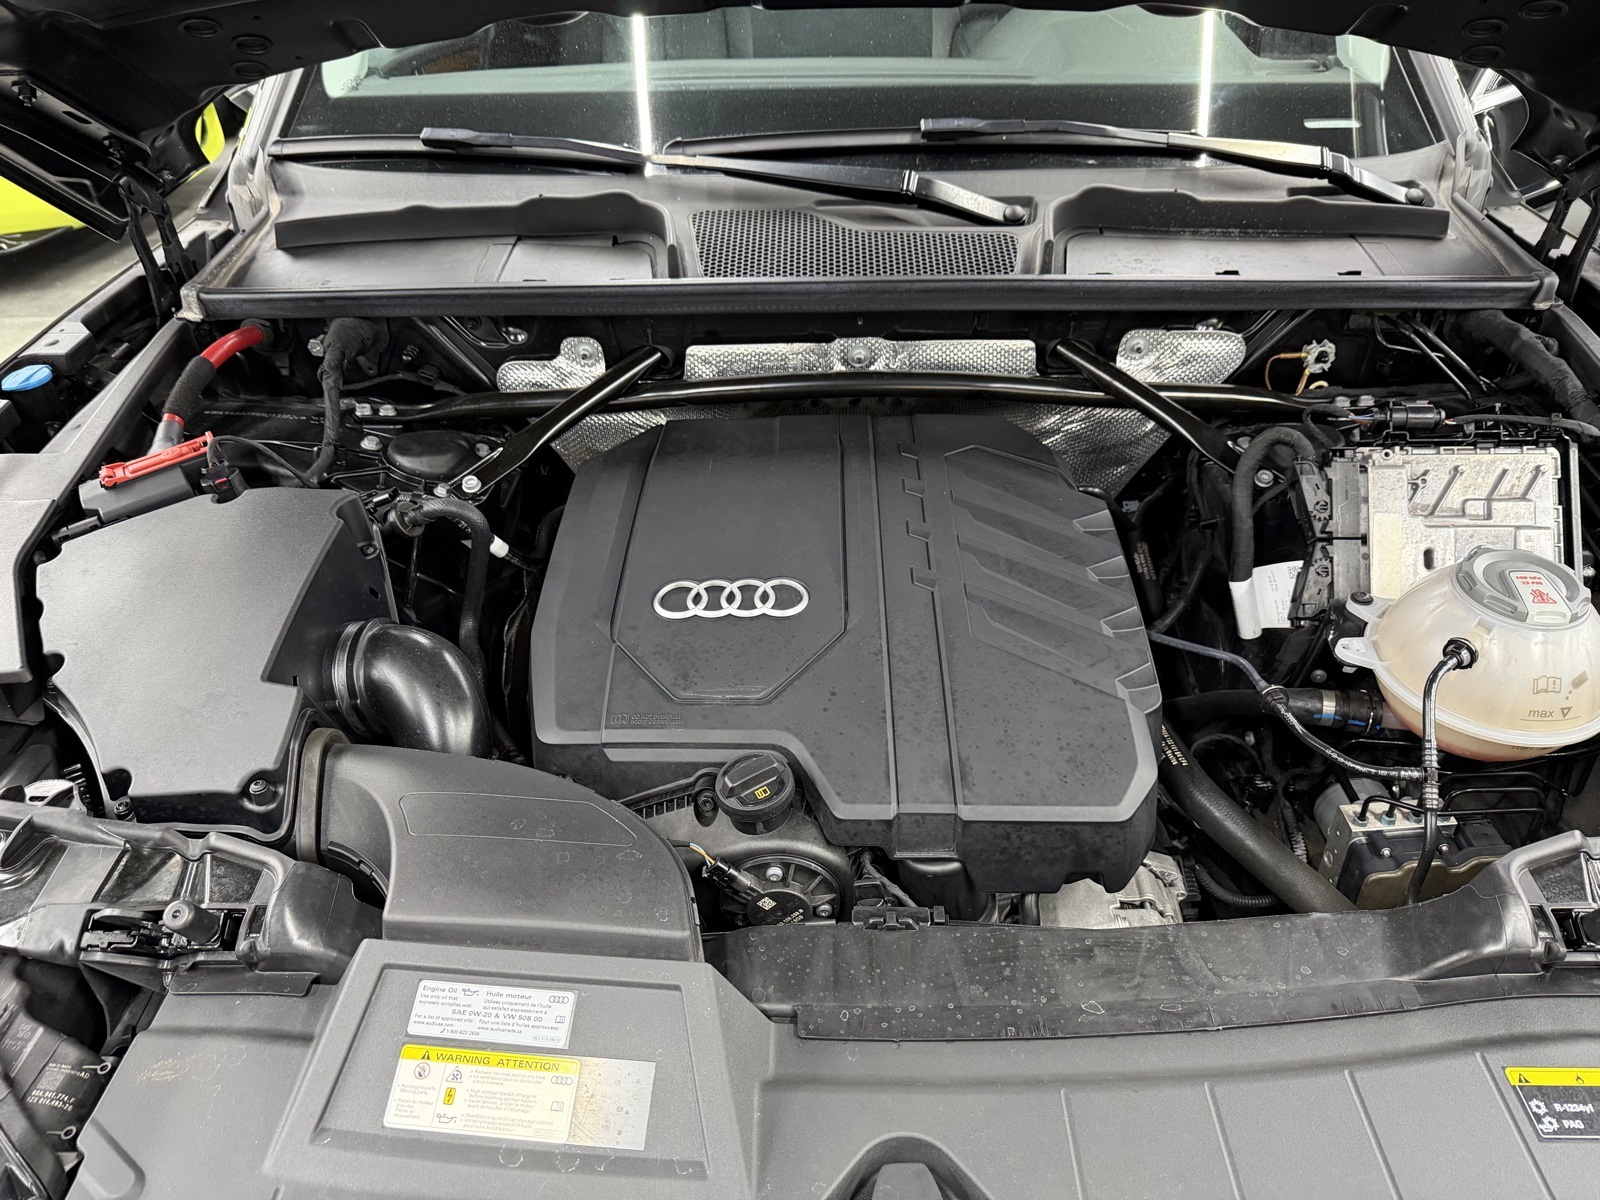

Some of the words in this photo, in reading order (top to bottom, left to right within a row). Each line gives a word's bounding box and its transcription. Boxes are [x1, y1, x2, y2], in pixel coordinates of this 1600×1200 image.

[1528, 709, 1554, 718] max
[436, 1052, 490, 1065] WARNING
[496, 1058, 560, 1071] ATTENTION
[1562, 1120, 1585, 1129] PAG
